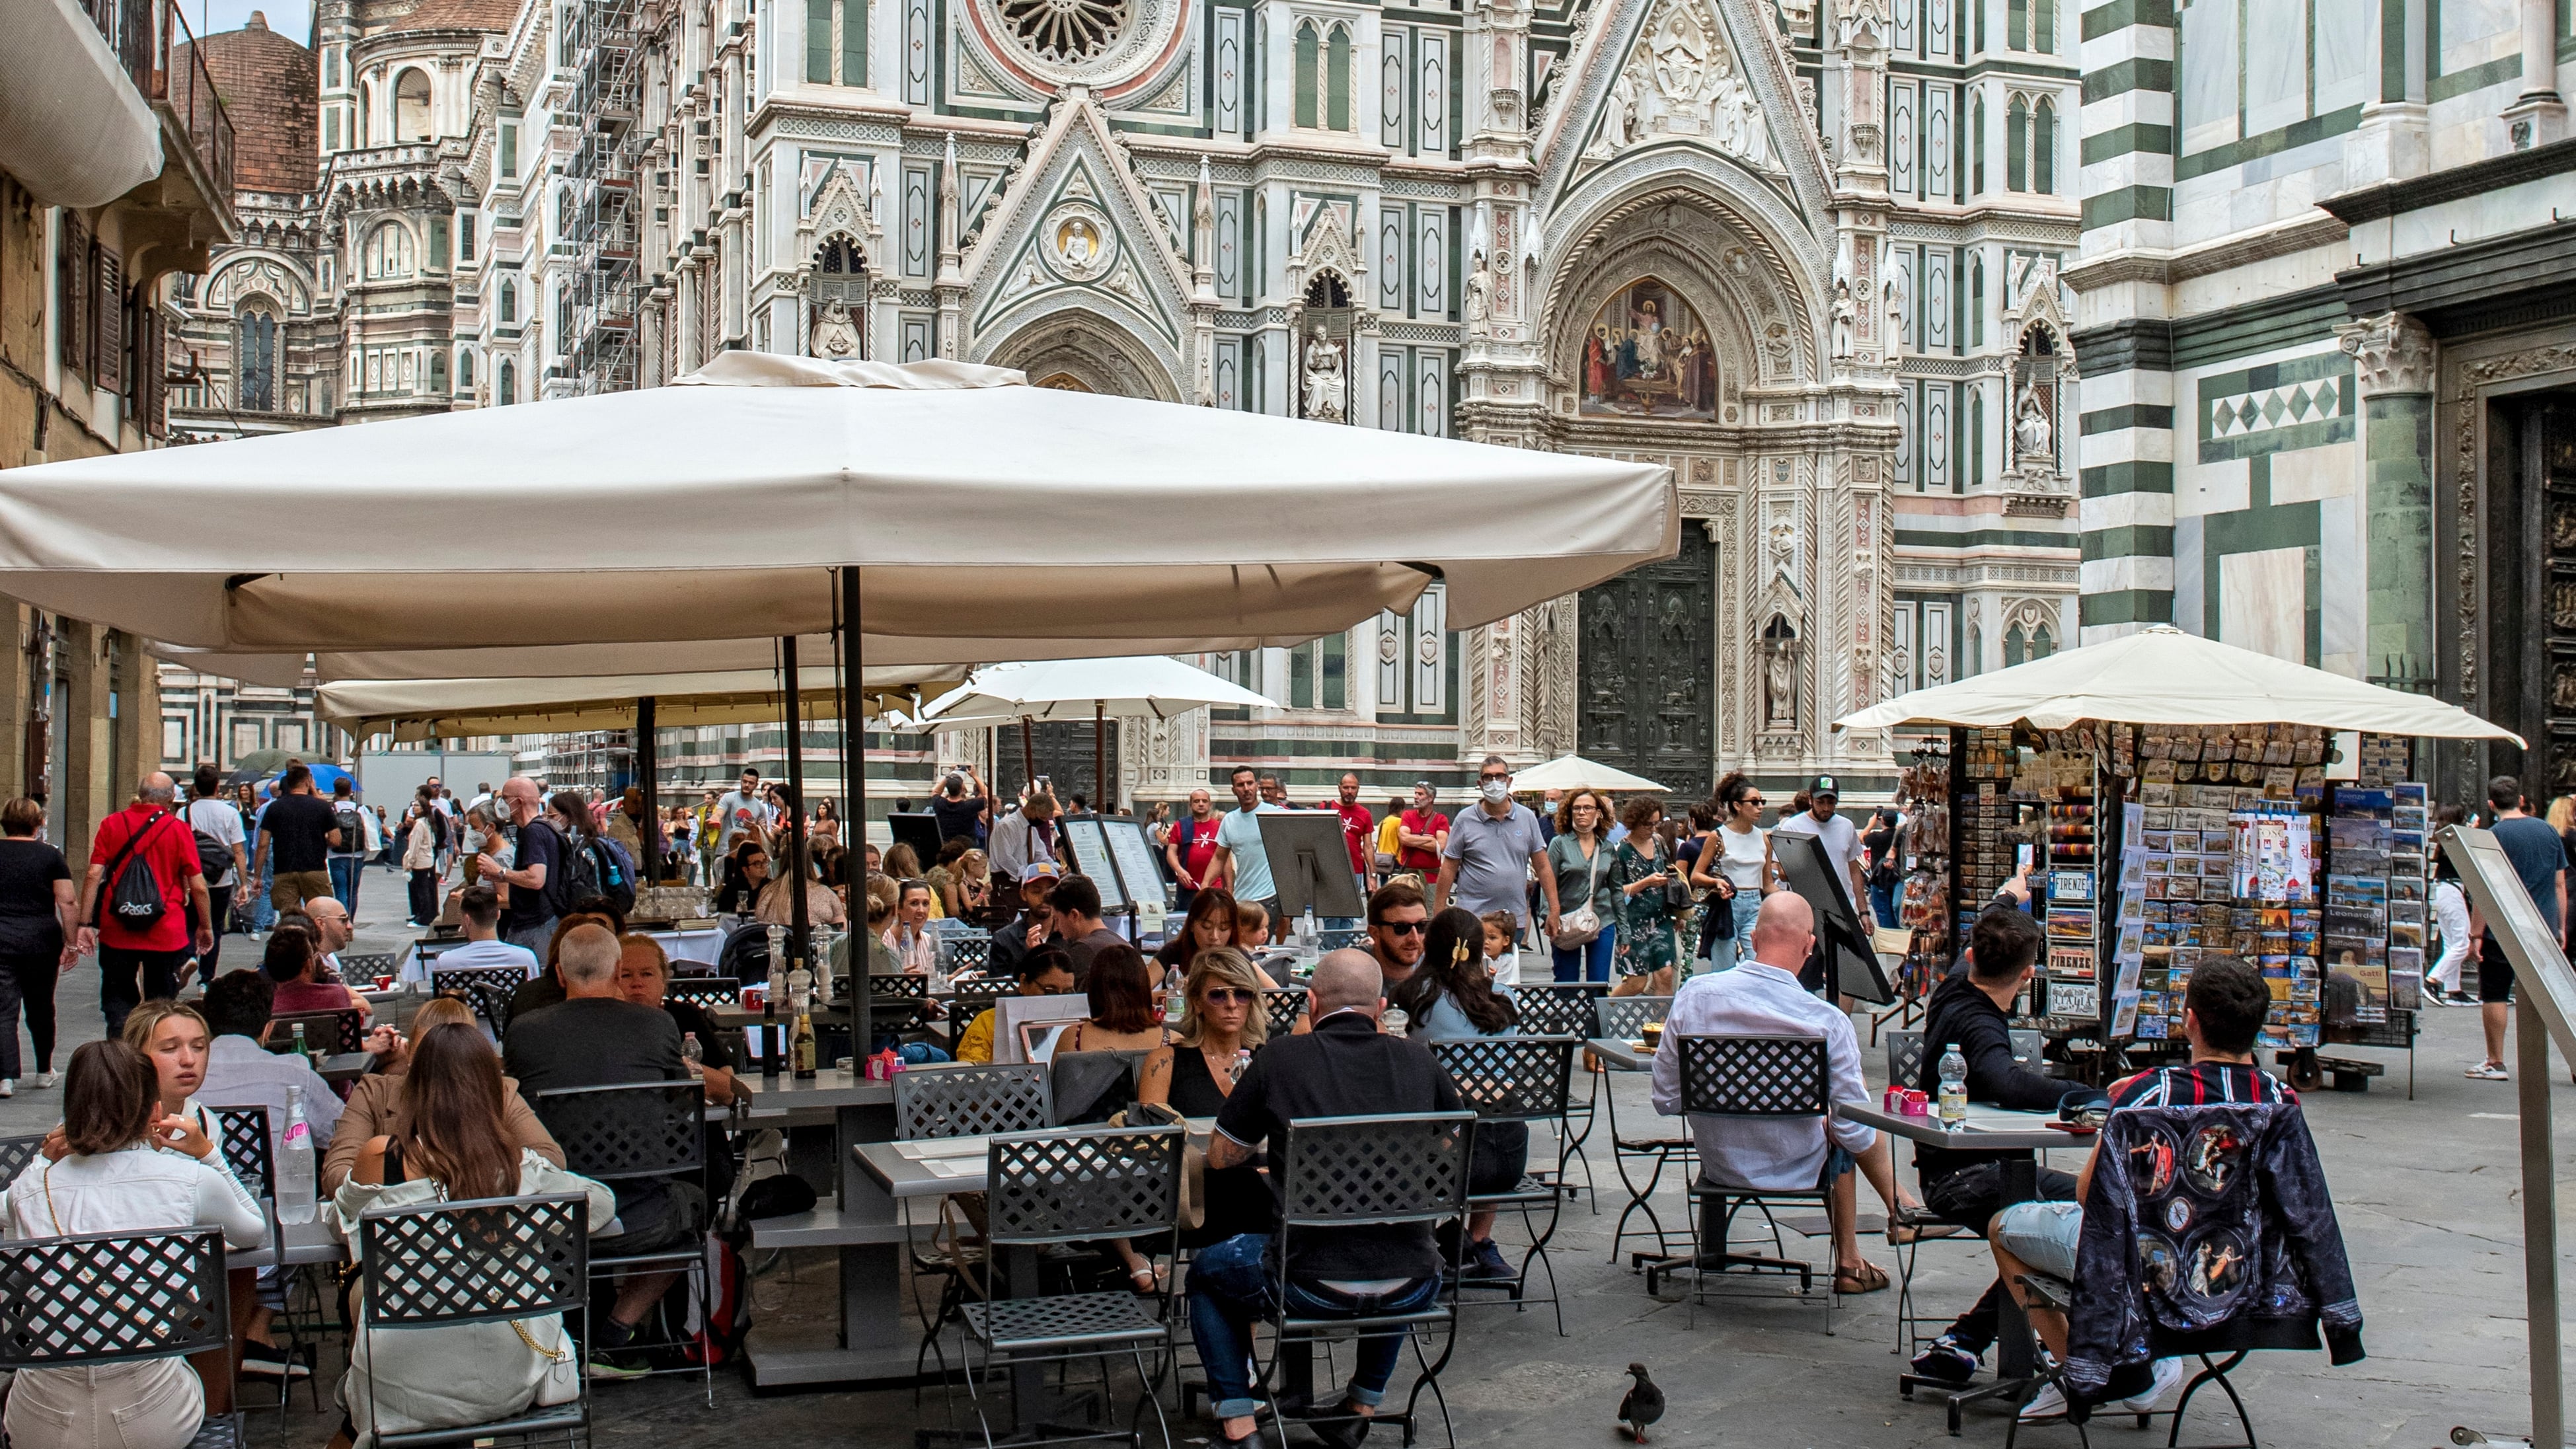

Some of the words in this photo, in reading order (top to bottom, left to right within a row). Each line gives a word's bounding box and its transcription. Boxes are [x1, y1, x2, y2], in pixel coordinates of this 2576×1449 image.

[2055, 877, 2086, 891] FIRENZE
[2330, 909, 2376, 919] Leonardo
[2327, 938, 2364, 949] Raffaello
[2050, 955, 2091, 969] FIRENZE
[2359, 969, 2382, 978] Gatti
